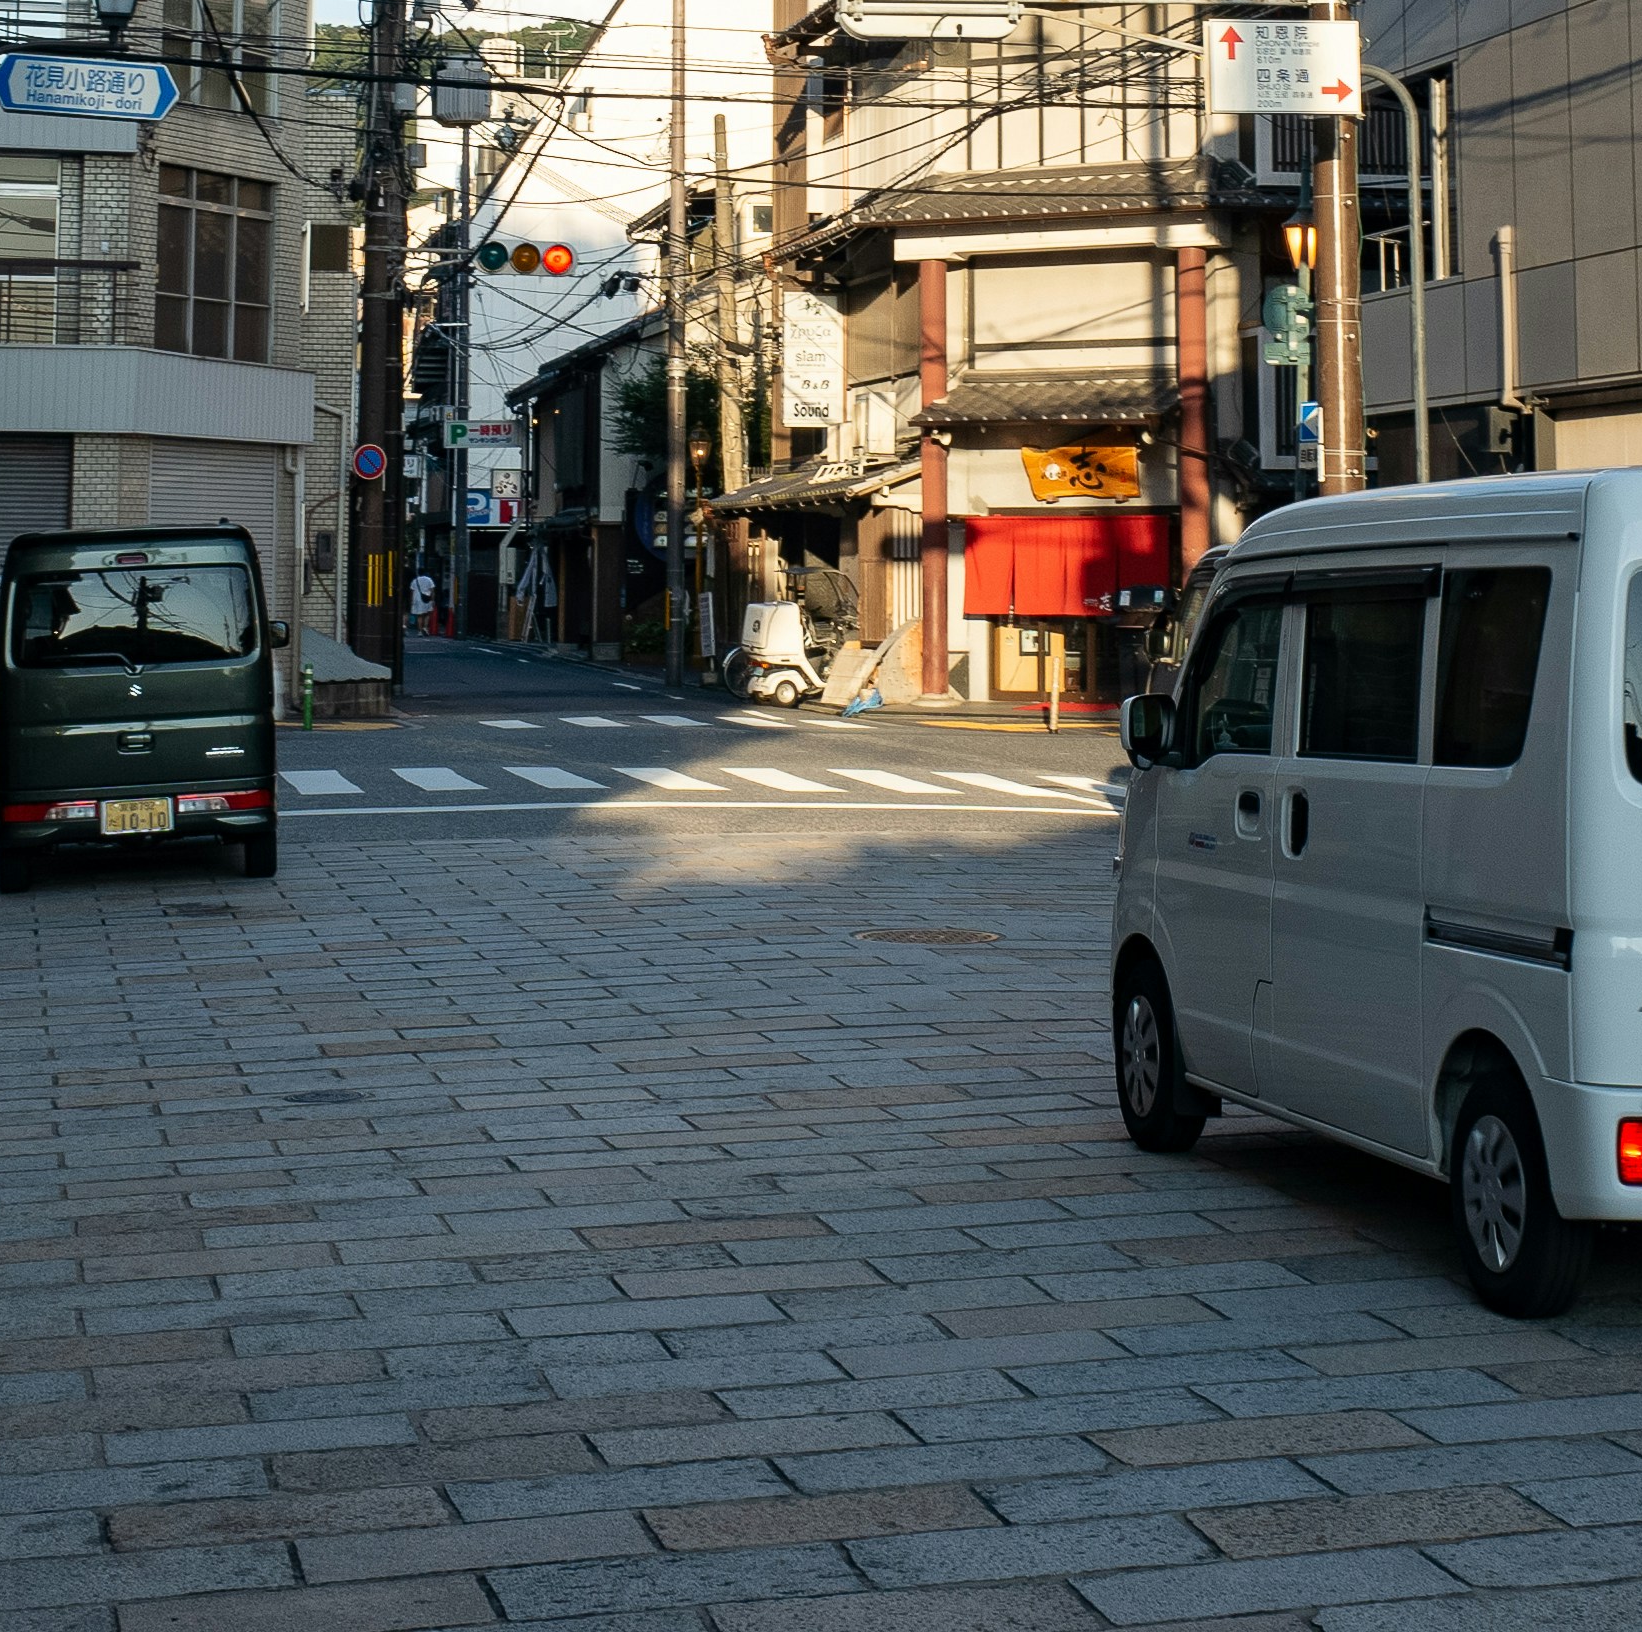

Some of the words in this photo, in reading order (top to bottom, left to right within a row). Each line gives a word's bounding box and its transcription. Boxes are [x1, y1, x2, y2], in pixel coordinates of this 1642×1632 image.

[1255, 25, 1308, 39] 知恩院
[1257, 56, 1282, 64] 610m
[25, 64, 145, 96] 花見小路通り
[1256, 68, 1309, 83] 四条通
[26, 89, 142, 110] Hanamikoji-dori
[1257, 100, 1282, 108] 200m
[795, 350, 826, 362] siam
[794, 402, 830, 418] Sound
[121, 811, 166, 830] 10-10
